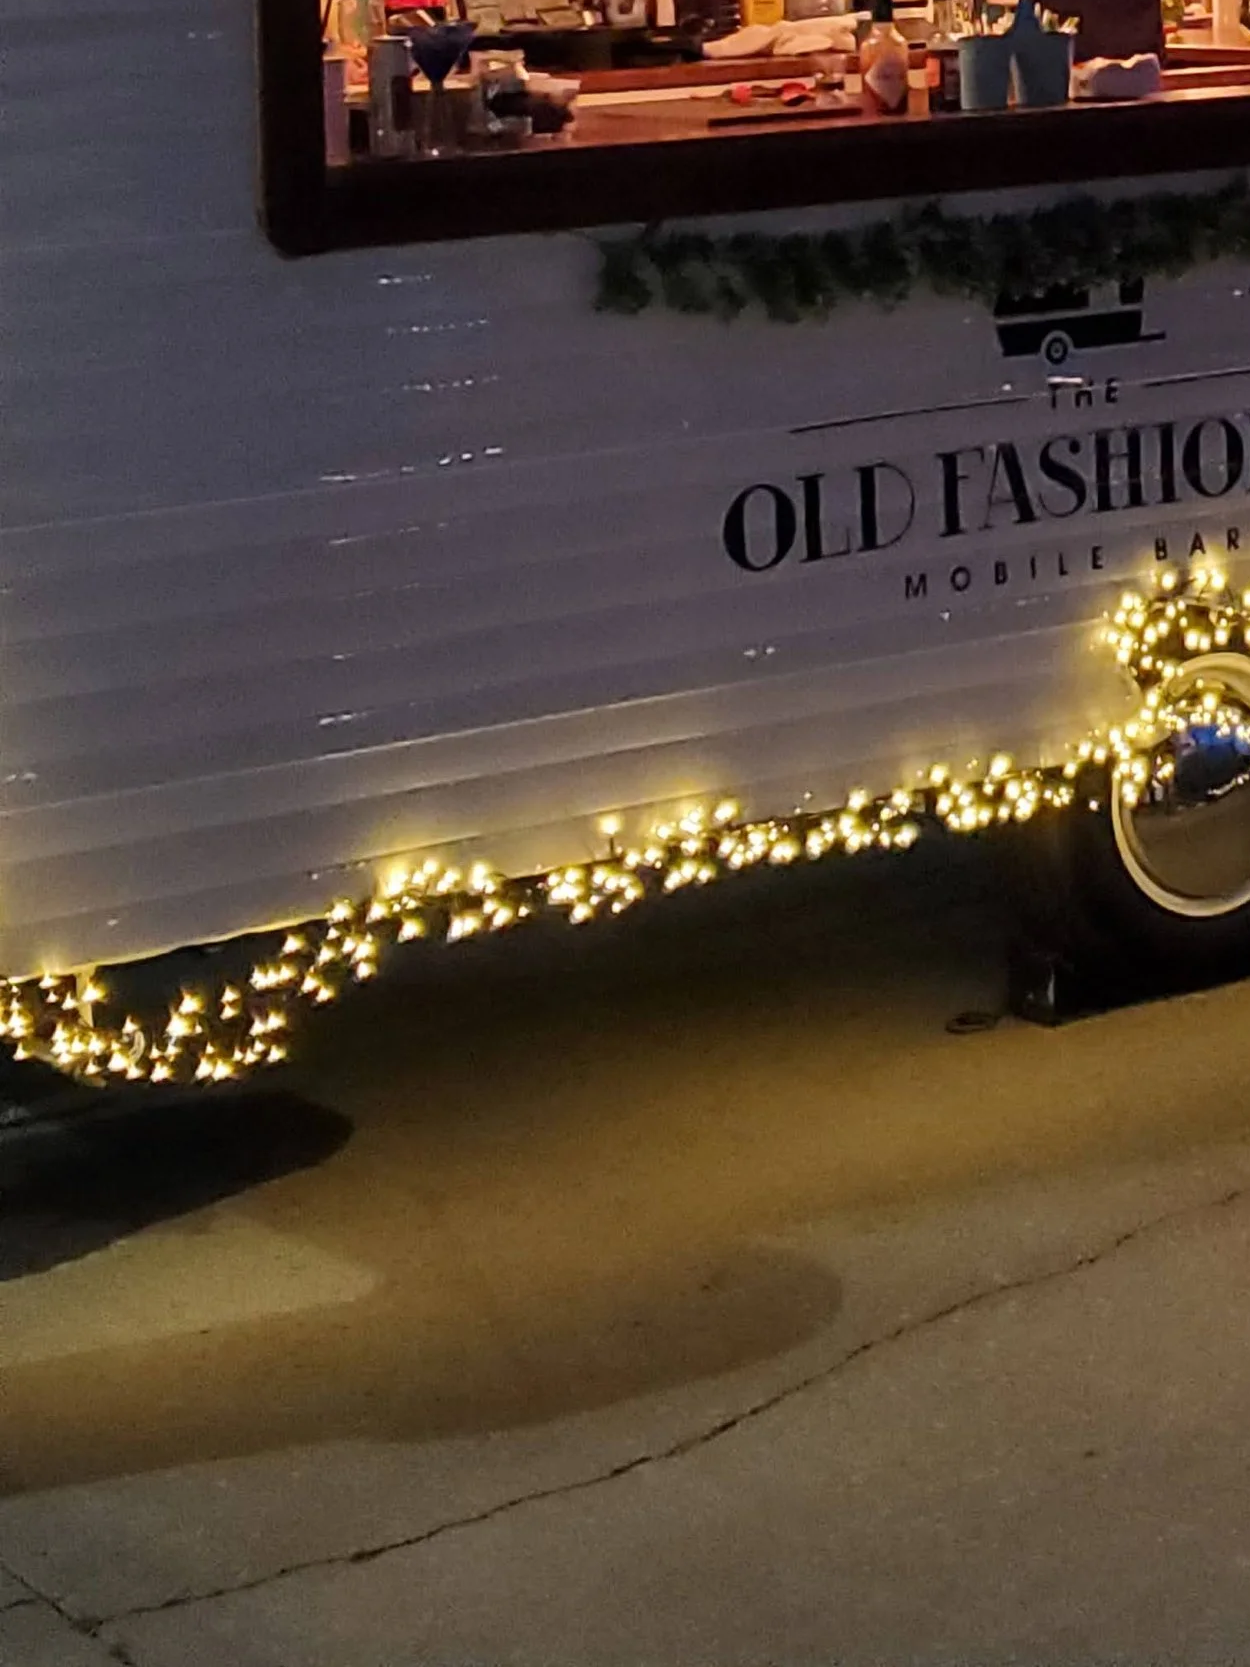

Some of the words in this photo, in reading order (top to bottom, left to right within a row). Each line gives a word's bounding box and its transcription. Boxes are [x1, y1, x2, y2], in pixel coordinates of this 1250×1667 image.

[1047, 375, 1120, 409] THE
[722, 460, 916, 573] OLD
[904, 544, 1105, 600] MOBILE
[1155, 527, 1242, 561] BAR
